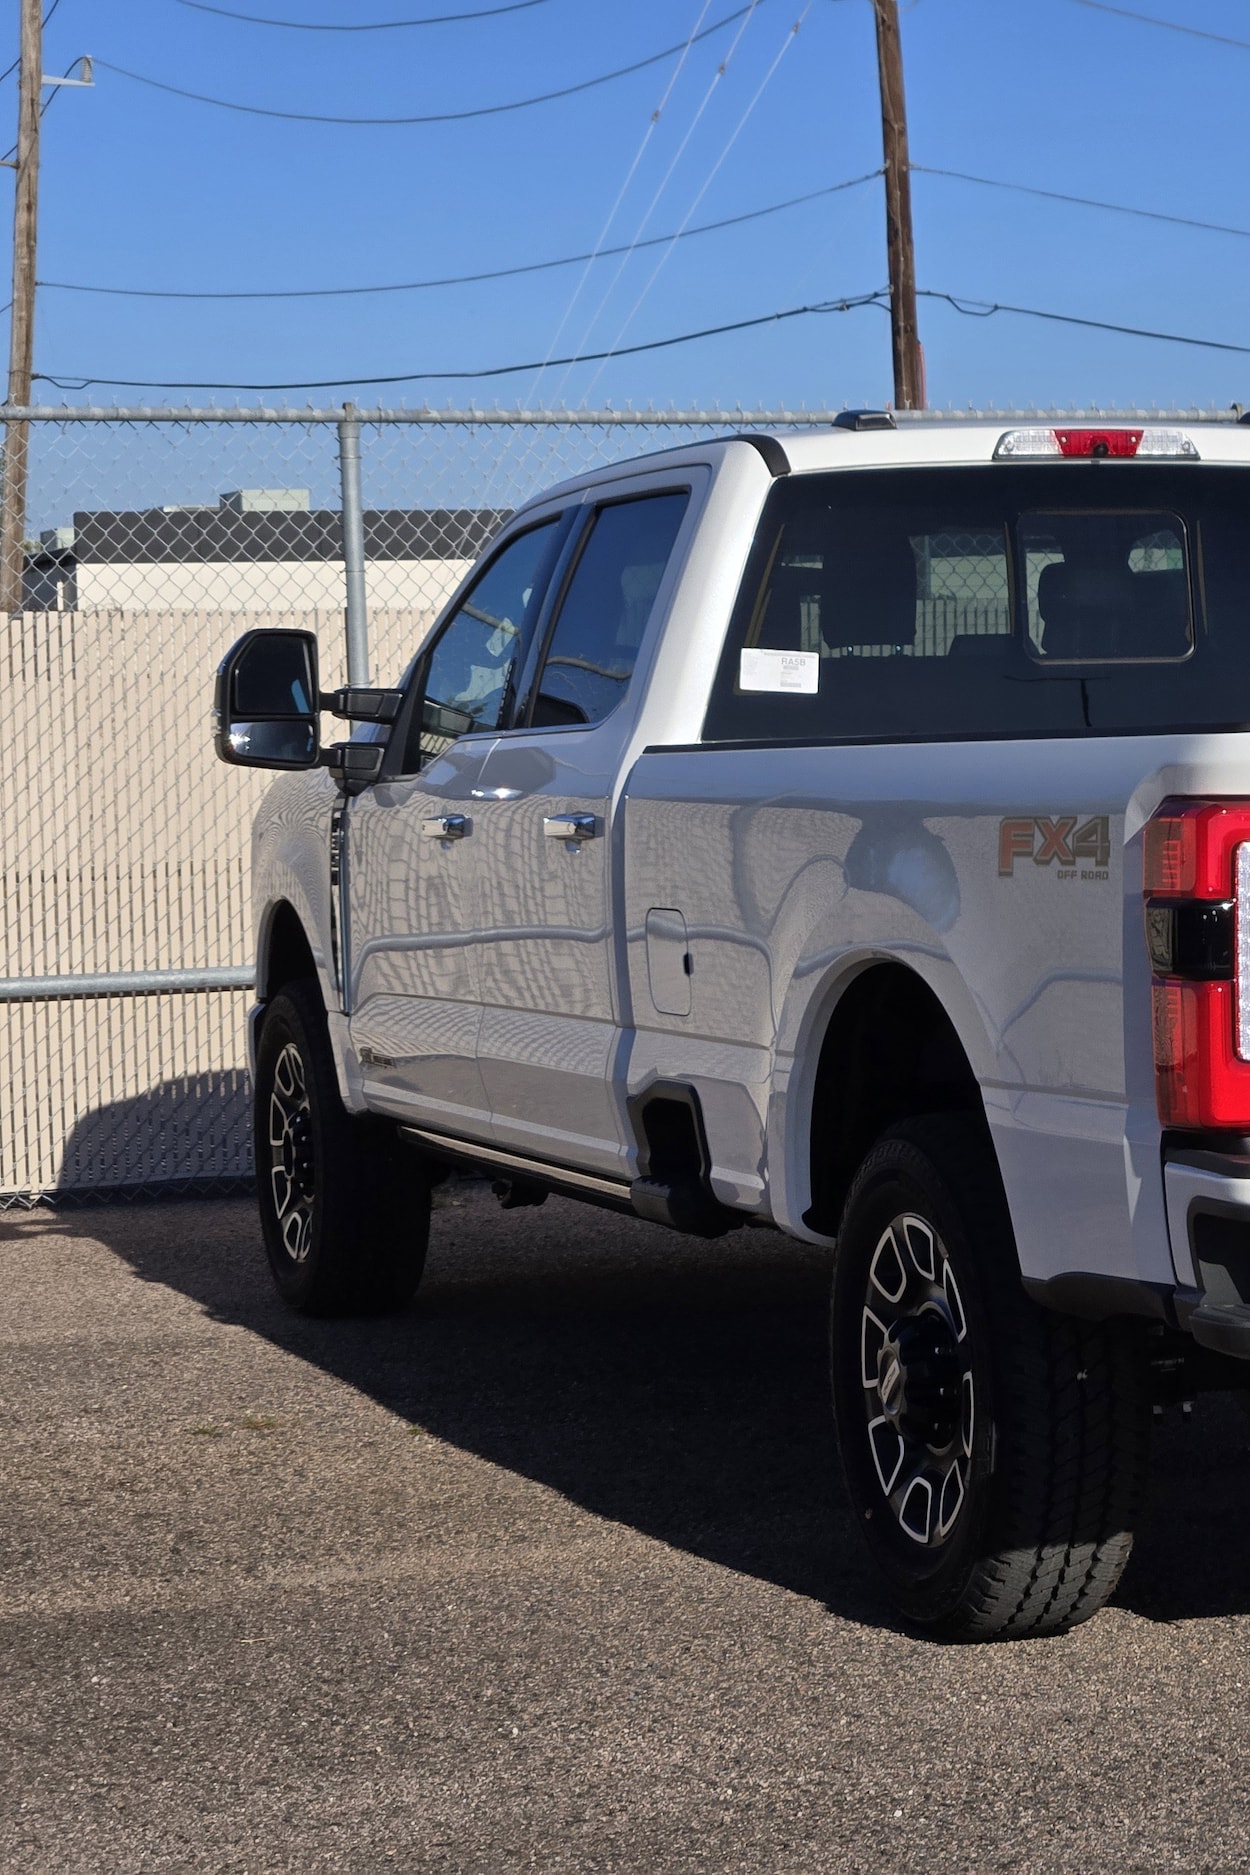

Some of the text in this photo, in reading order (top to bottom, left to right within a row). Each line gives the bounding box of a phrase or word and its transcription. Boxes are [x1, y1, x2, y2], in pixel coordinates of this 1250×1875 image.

[998, 815, 1110, 877] FX4
[1057, 870, 1109, 880] OFF ROAD
